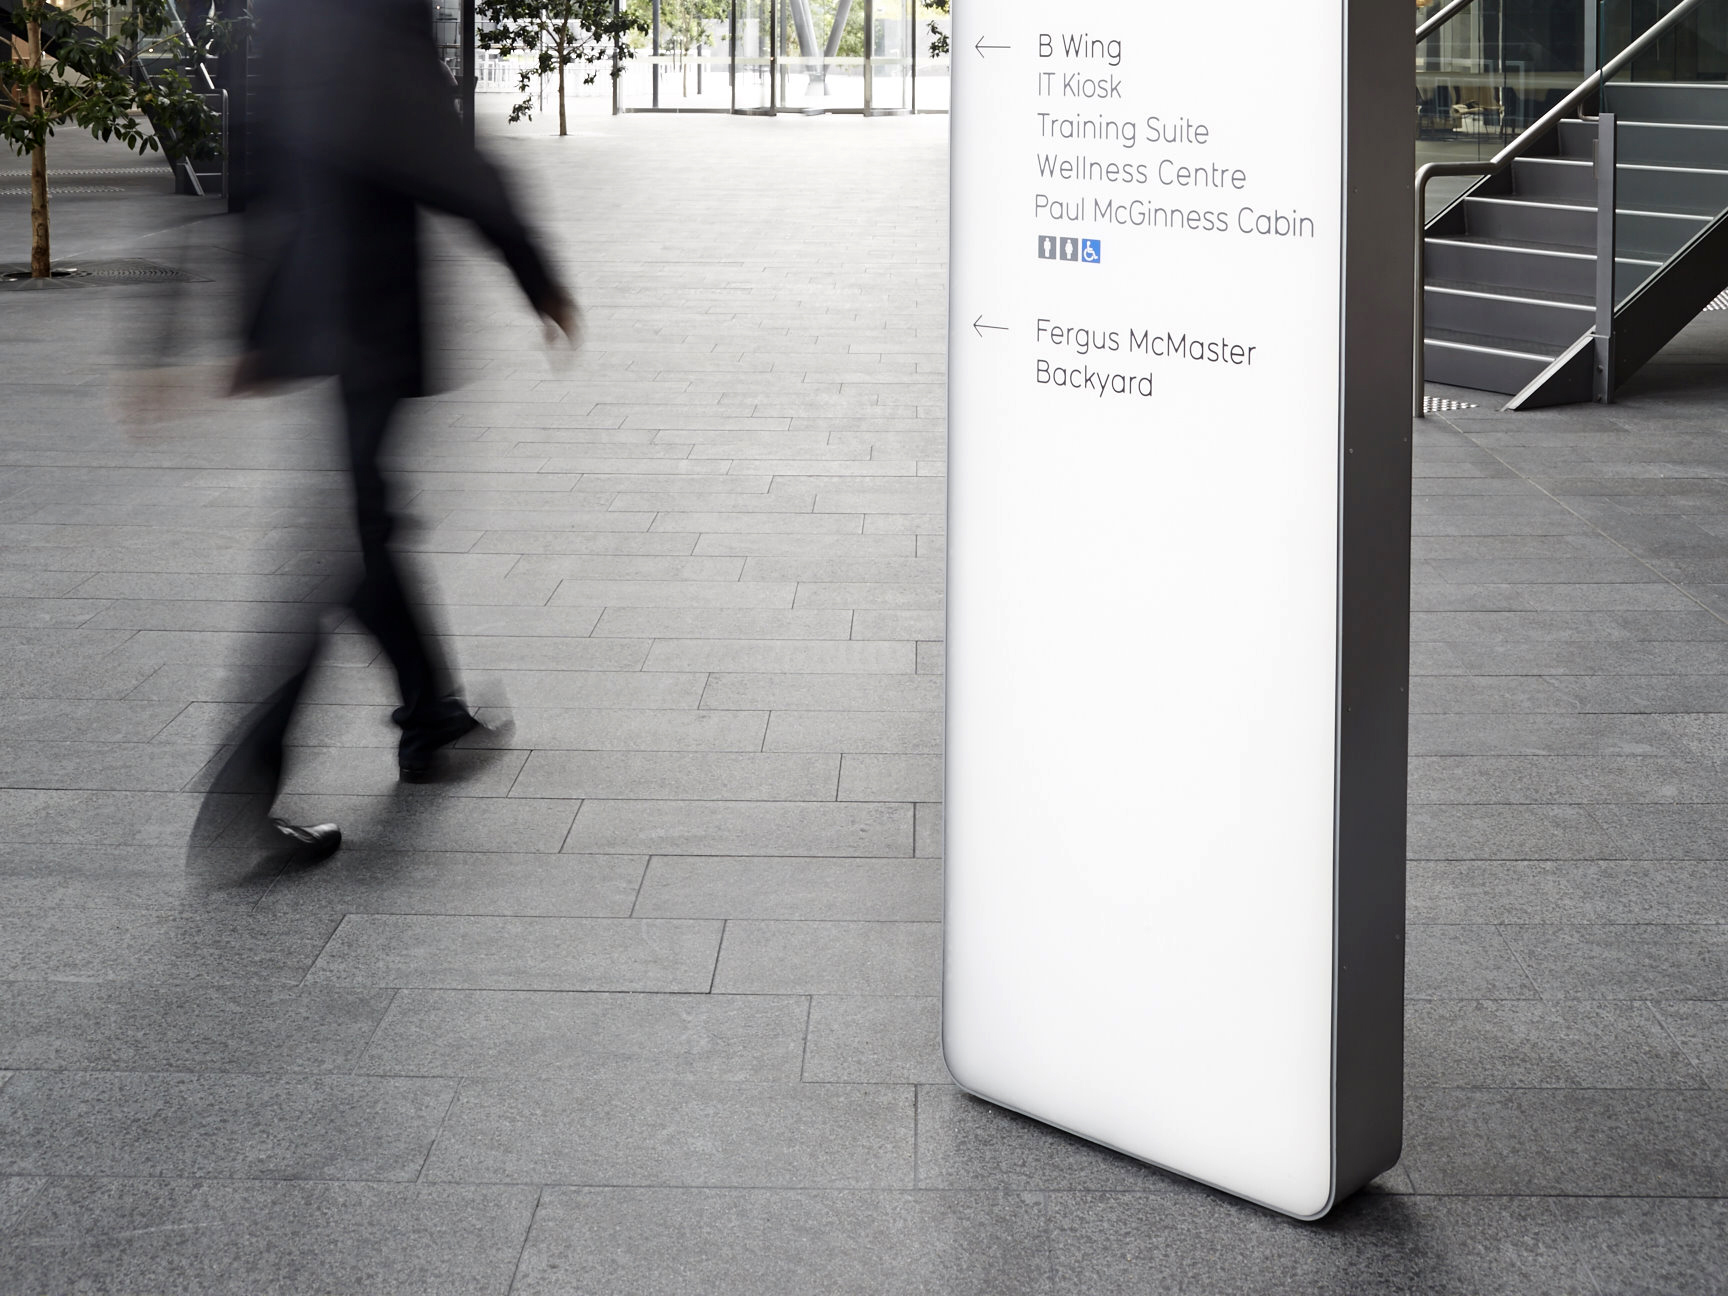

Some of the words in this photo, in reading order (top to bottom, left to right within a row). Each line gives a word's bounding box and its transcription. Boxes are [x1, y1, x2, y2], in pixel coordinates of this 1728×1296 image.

[1039, 34, 1053, 57] B
[1062, 33, 1121, 66] Wing
[1039, 72, 1056, 96] IT
[1064, 72, 1121, 98] Kiosk
[1037, 113, 1135, 148] Training
[1146, 117, 1209, 144] Suite
[1037, 154, 1147, 184] Wellness
[1159, 159, 1246, 189] Centre
[1036, 194, 1084, 221] Paul
[1094, 198, 1228, 232] McGinness
[1238, 207, 1314, 238] Cabin
[1037, 318, 1119, 355] Fergus
[1130, 328, 1256, 366] McMaster
[1037, 359, 1152, 398] Backyard
